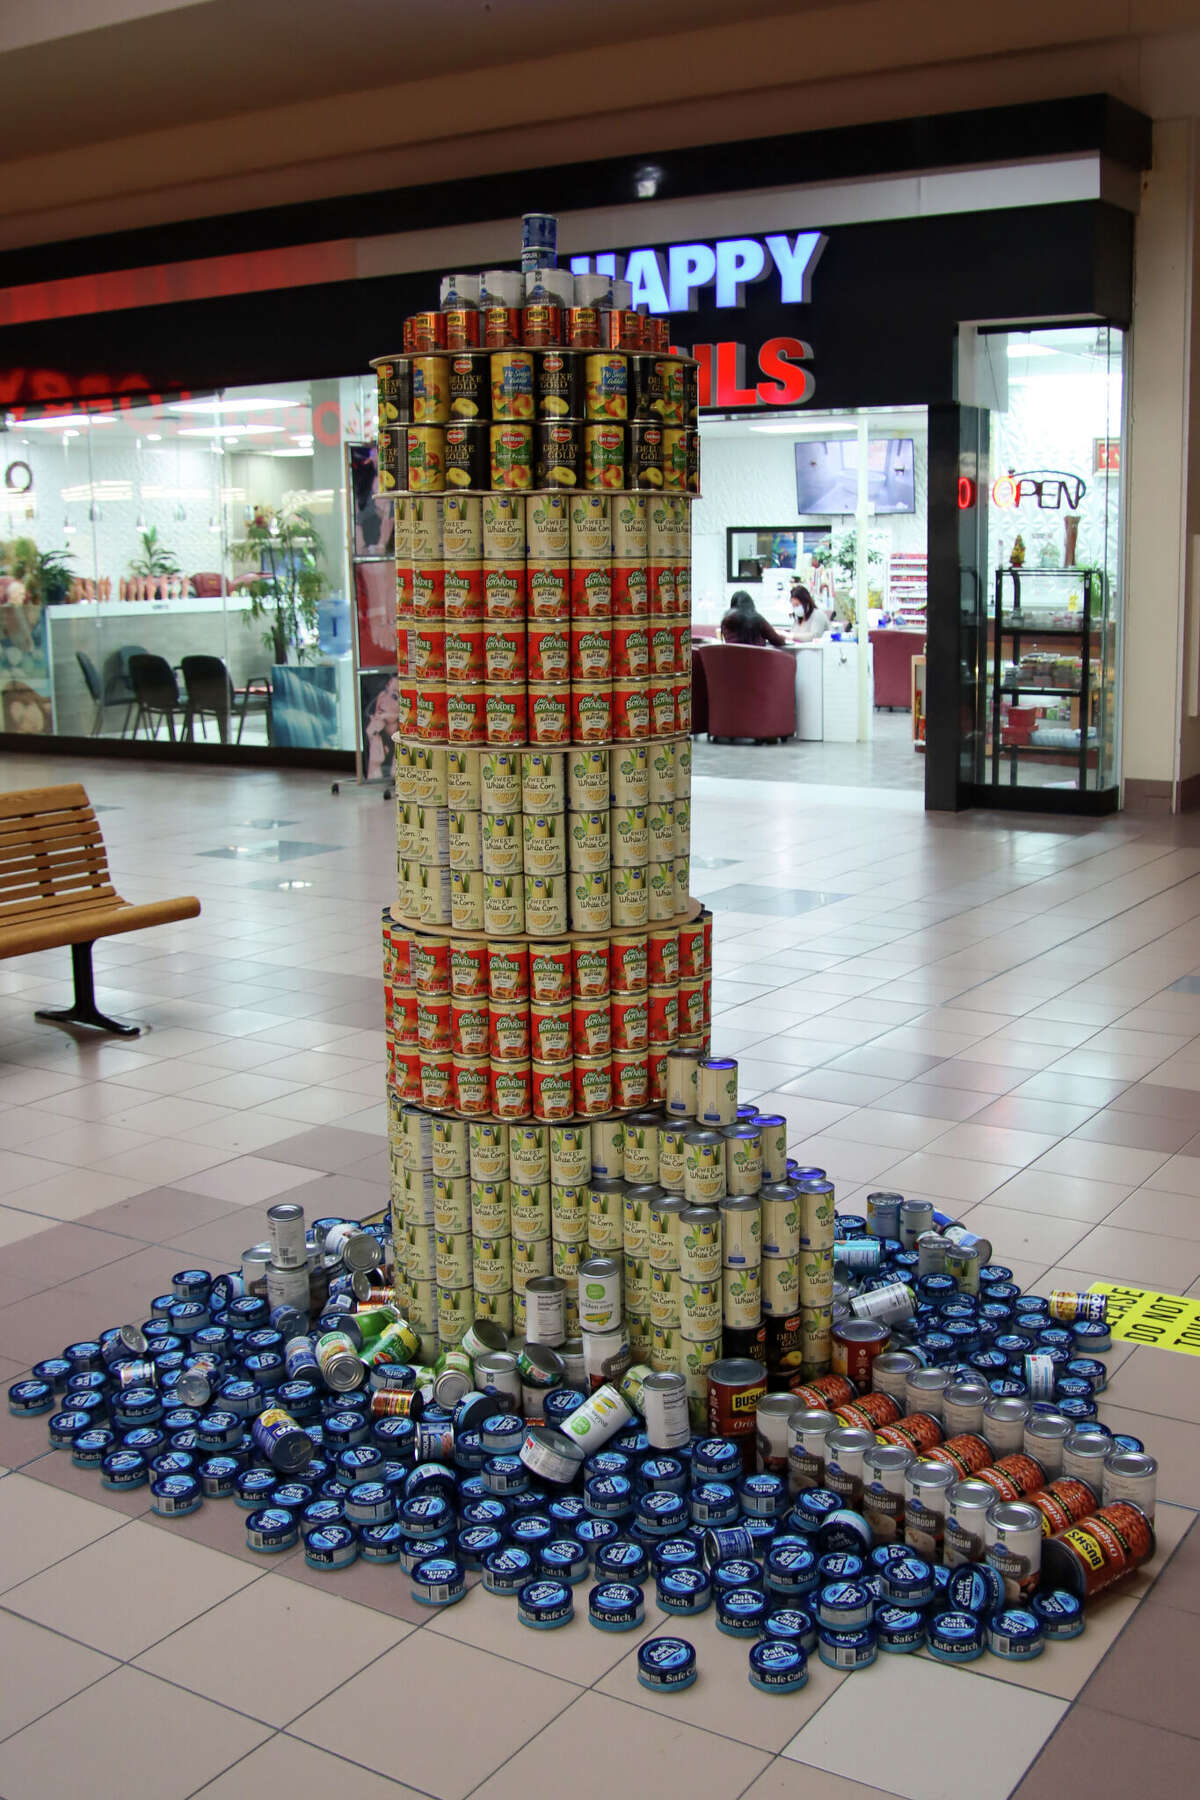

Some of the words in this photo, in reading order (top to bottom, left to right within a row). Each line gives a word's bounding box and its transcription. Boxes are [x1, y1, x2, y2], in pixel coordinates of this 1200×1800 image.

[669, 337, 806, 408] ILS
[992, 475, 1081, 510] OPEN
[1106, 1287, 1145, 1327] EASE
[1142, 1296, 1190, 1323] NOT
[1123, 1323, 1166, 1343] DO
[664, 1595, 690, 1607] Catch
[540, 1611, 559, 1621] Safe
[605, 1612, 632, 1622] Catch
[953, 1643, 978, 1652] Catch
[765, 1674, 786, 1684] Safe
